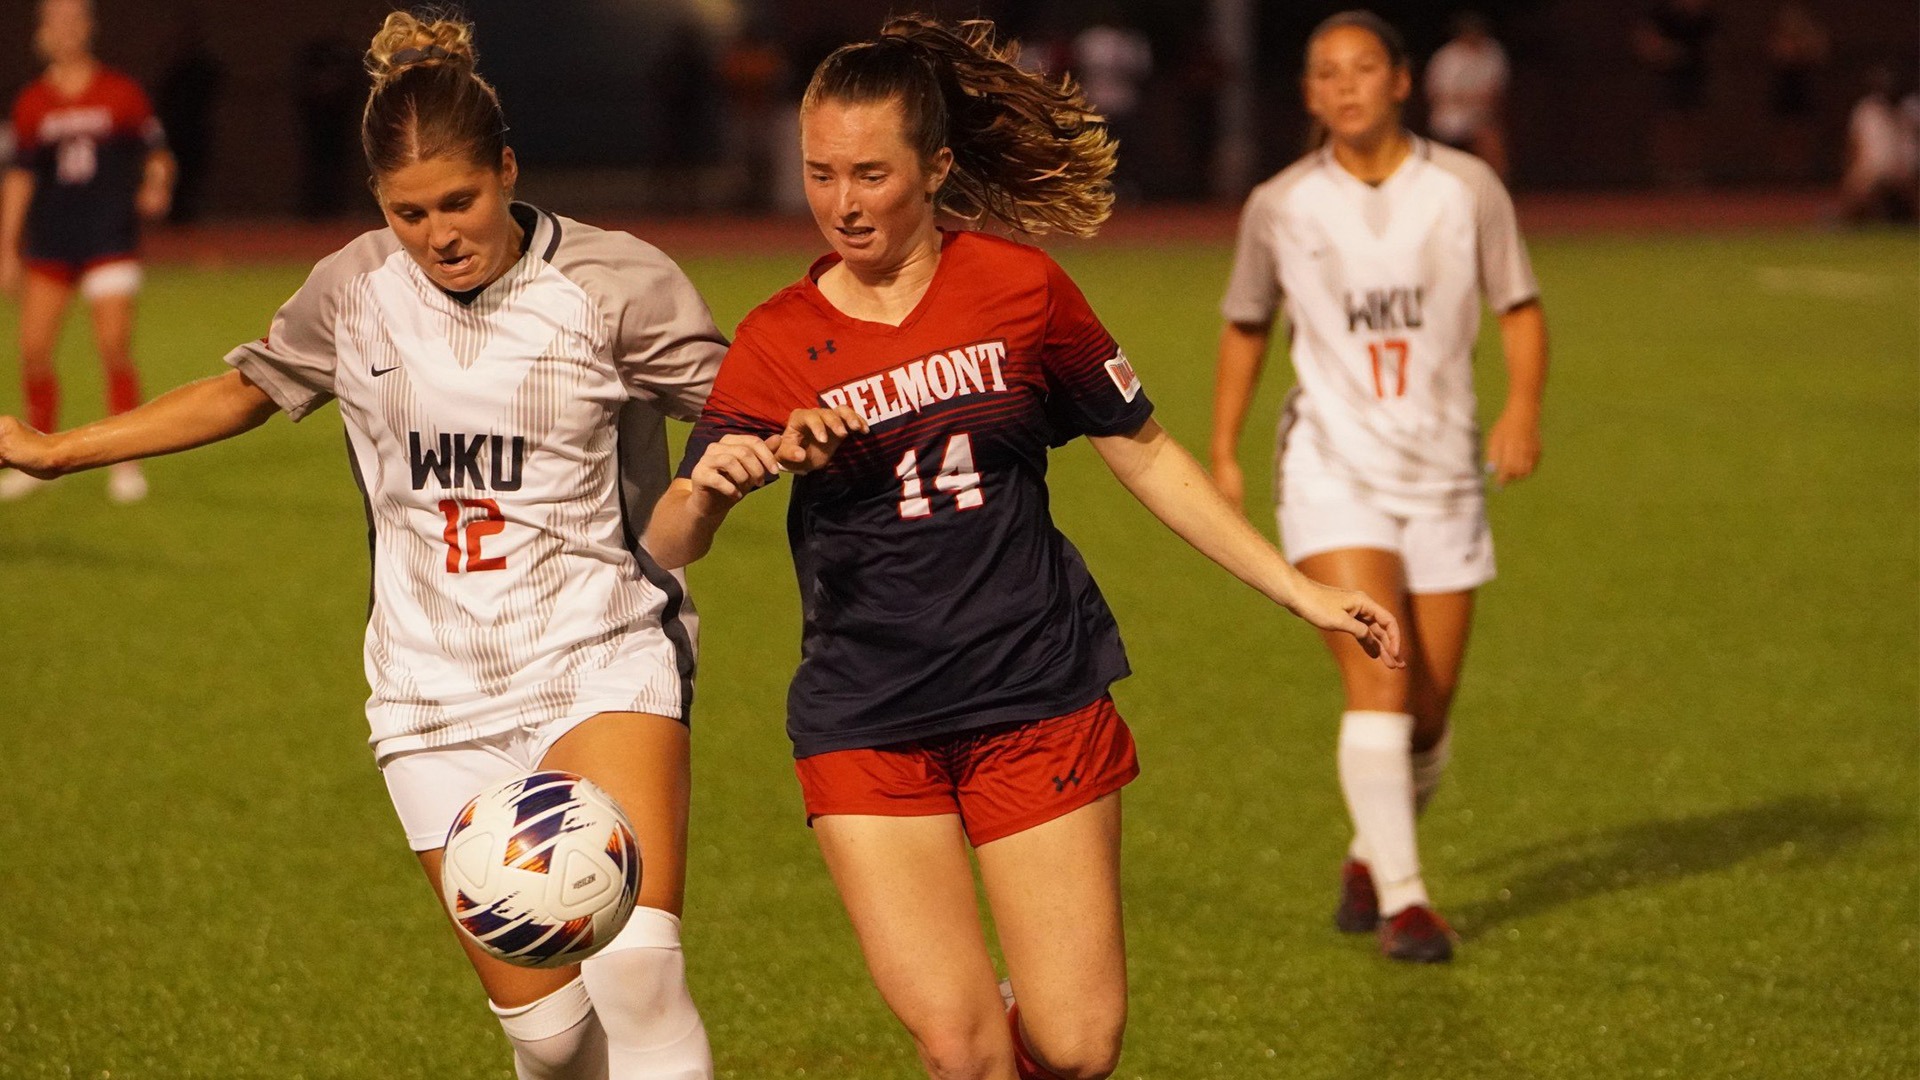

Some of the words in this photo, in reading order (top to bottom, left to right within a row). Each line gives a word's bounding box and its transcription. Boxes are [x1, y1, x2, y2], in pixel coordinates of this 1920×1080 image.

[1343, 287, 1424, 332] WKU
[1367, 339, 1408, 398] 17
[409, 431, 524, 492] WKU
[895, 432, 985, 519] 14
[438, 498, 507, 573] 12
